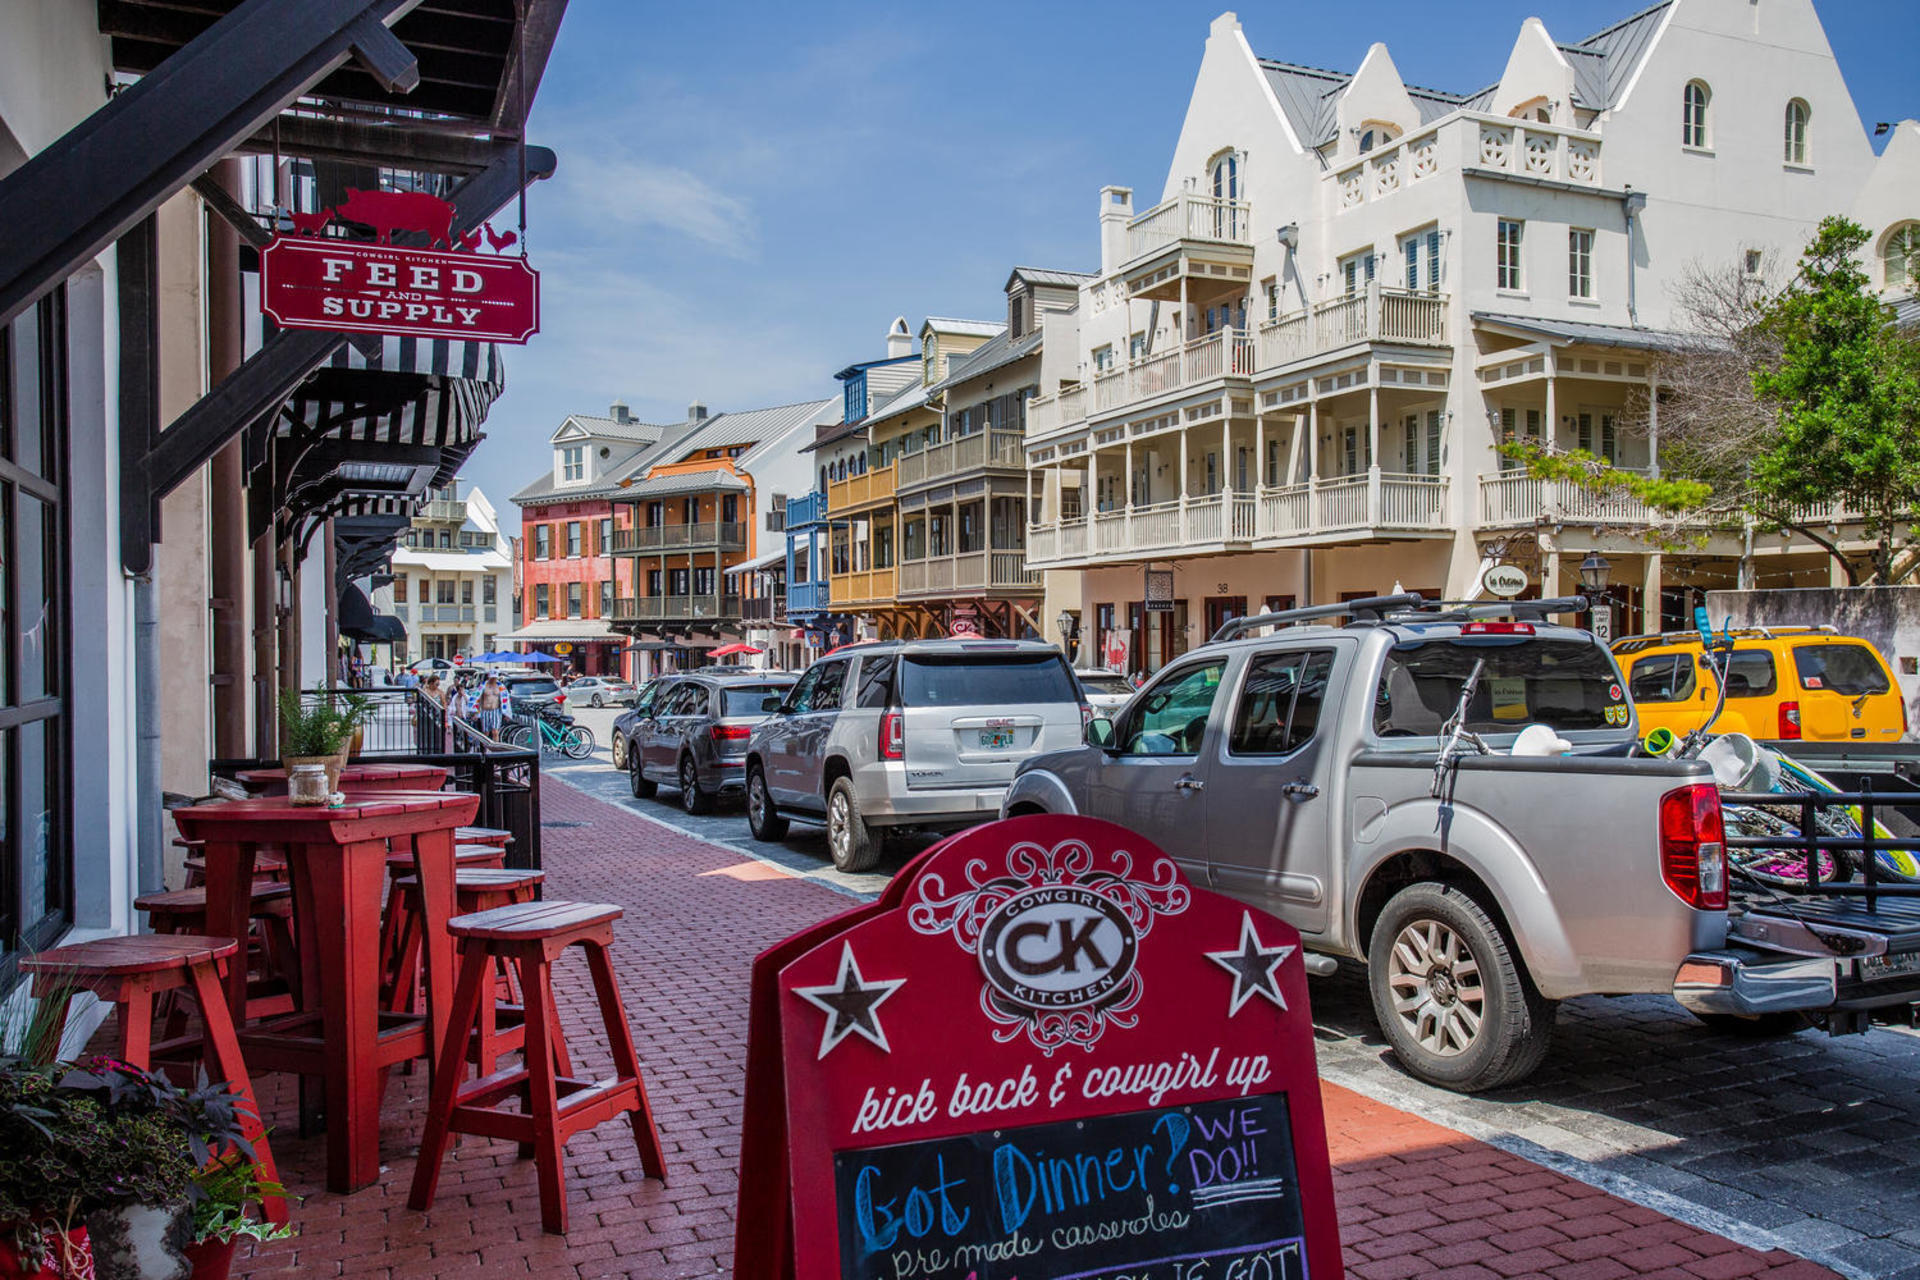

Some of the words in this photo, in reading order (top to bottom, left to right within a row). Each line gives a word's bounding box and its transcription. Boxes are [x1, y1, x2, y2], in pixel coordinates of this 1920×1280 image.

[355, 251, 400, 261] COWGIRL
[405, 256, 449, 265] KITCHEN
[322, 258, 484, 293] FEED
[385, 291, 422, 301] AND
[322, 297, 481, 325] SUPPLY
[1216, 583, 1229, 594] 38
[1596, 624, 1608, 638] 12
[986, 718, 1015, 727] GMC
[1005, 890, 1108, 918] COWGIRL
[1003, 915, 1112, 978] CK
[1012, 975, 1115, 1004] KITCHEN
[851, 1078, 938, 1134] kick
[948, 1064, 1039, 1118] back
[1048, 1062, 1072, 1108] &
[1082, 1047, 1221, 1106] cowgirl
[1226, 1054, 1272, 1096] up
[1193, 1107, 1268, 1141] WE
[1188, 1139, 1259, 1188] DO!!
[856, 1153, 971, 1252] Got
[993, 1112, 1191, 1234] Dinner?
[892, 1249, 950, 1280] pre
[953, 1230, 1044, 1268] made
[1051, 1194, 1191, 1250] casseroles
